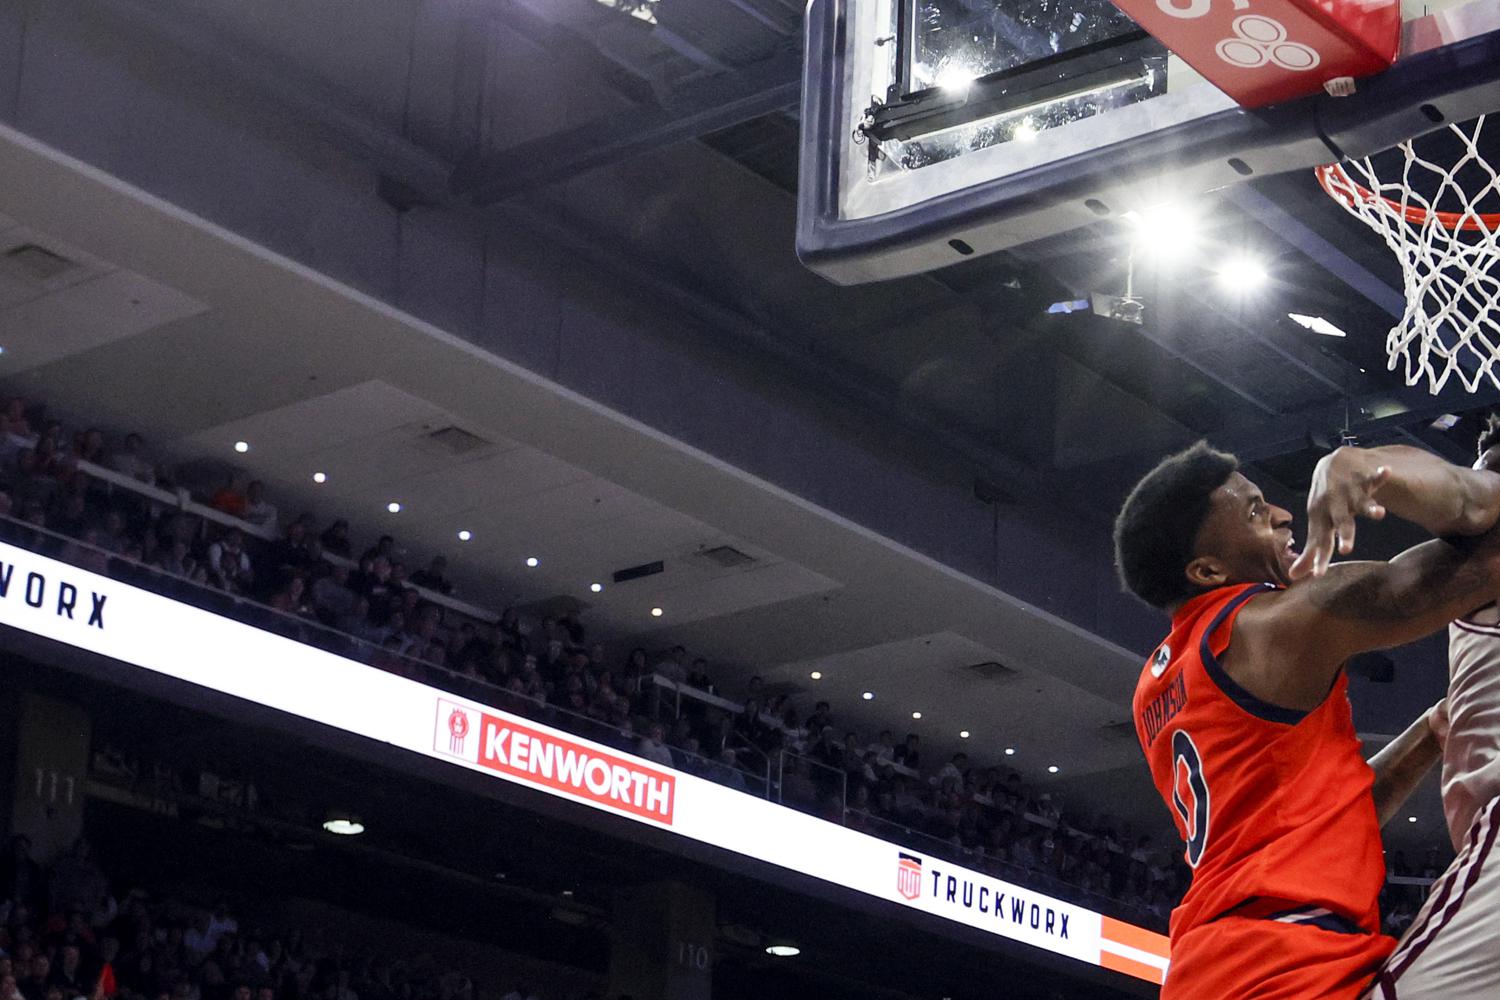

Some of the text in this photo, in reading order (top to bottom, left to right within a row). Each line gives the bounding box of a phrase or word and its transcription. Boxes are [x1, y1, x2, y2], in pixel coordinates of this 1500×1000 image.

[484, 722, 670, 816] KENWORTH
[1172, 728, 1210, 869] 0
[931, 869, 1070, 940] TRUCKWORX
